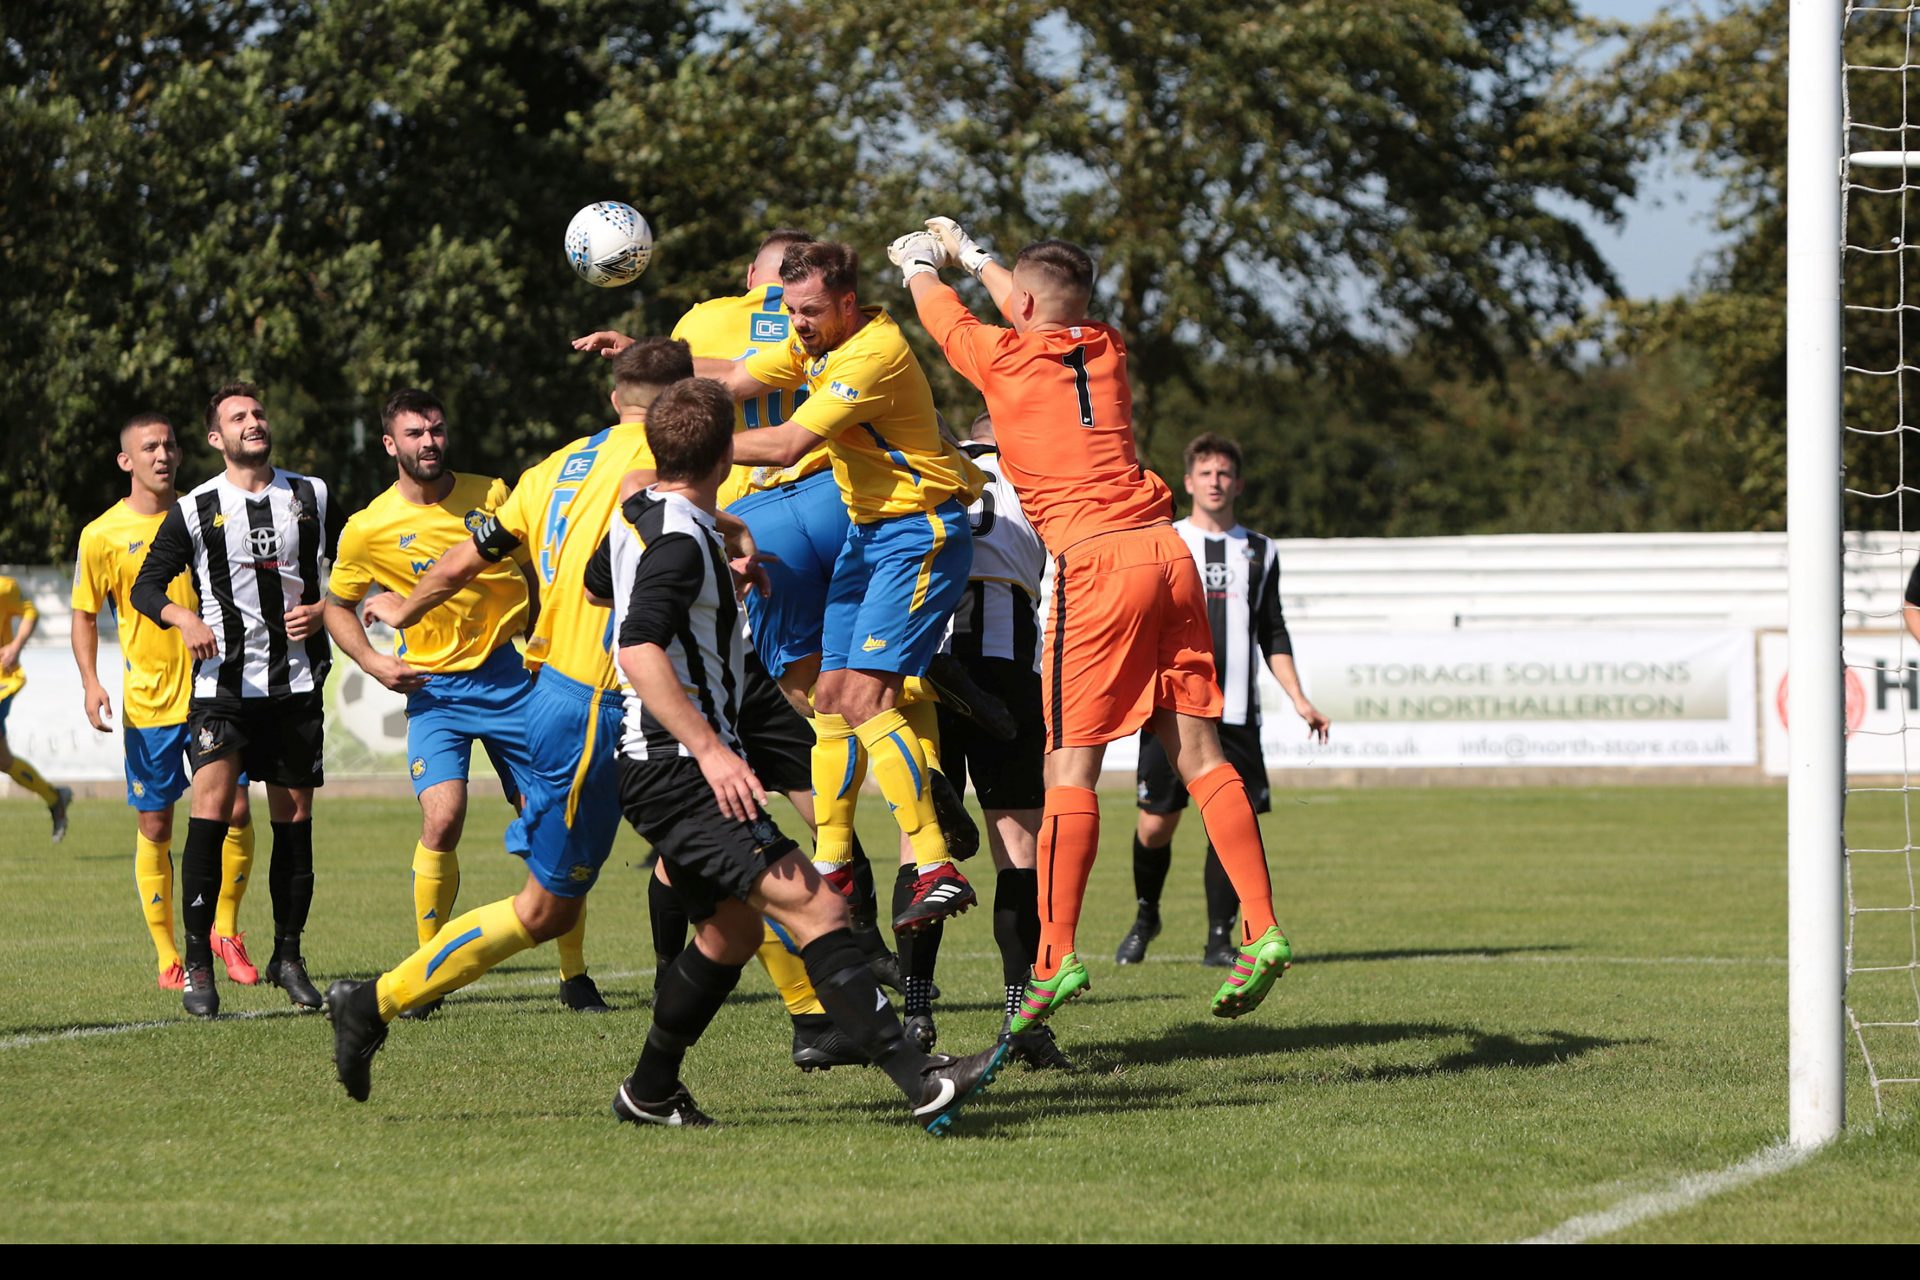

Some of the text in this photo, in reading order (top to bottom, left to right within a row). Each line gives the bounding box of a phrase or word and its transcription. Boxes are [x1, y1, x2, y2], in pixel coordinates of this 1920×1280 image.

[831, 381, 859, 400] MM
[1062, 345, 1095, 427] 1
[1347, 660, 1692, 686] STORAGE SOLUTIONS
[1876, 660, 1919, 710] H
[1353, 693, 1685, 719] IN NORTHALLERTON
[1459, 733, 1732, 758] info@north-store.co.uk
